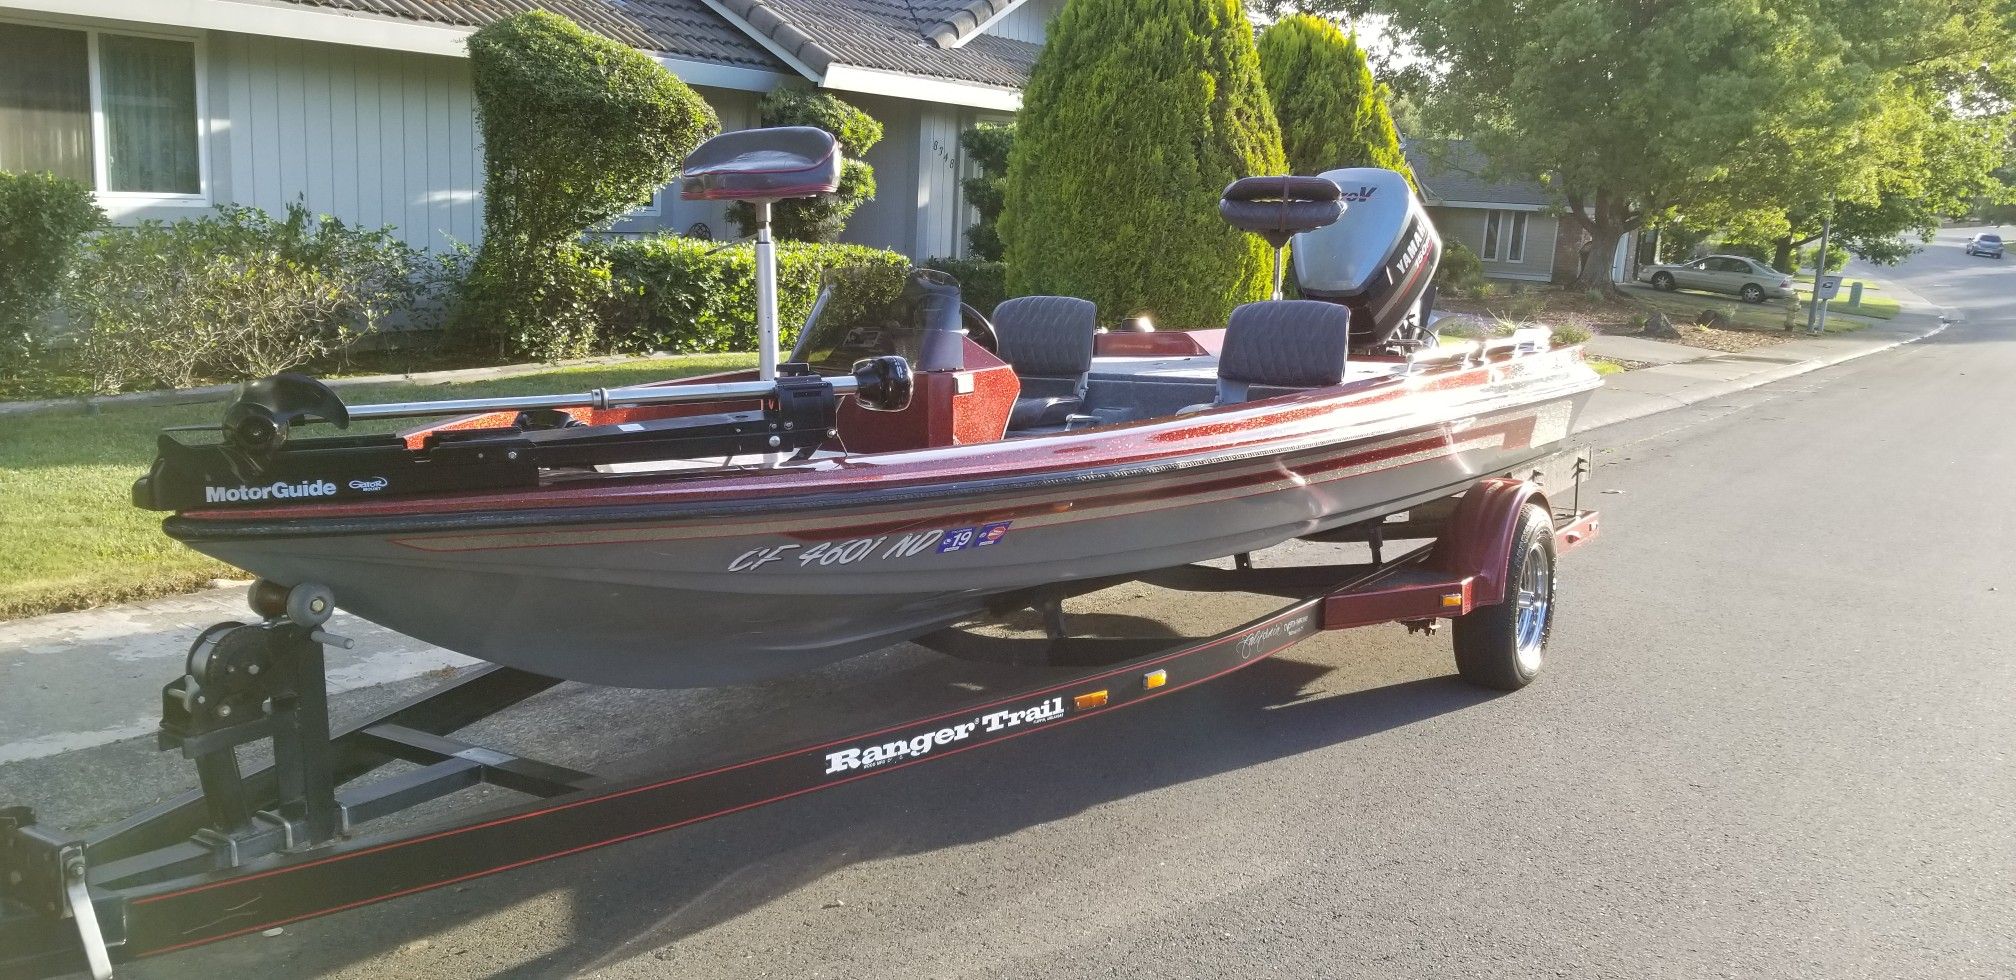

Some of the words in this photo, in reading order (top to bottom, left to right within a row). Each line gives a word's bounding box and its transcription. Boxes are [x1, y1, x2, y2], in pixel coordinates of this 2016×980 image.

[206, 480, 337, 503] MotorGuide
[728, 544, 801, 573] CF
[882, 529, 945, 560] ND
[952, 531, 973, 547] 19
[982, 697, 1065, 733] Trail
